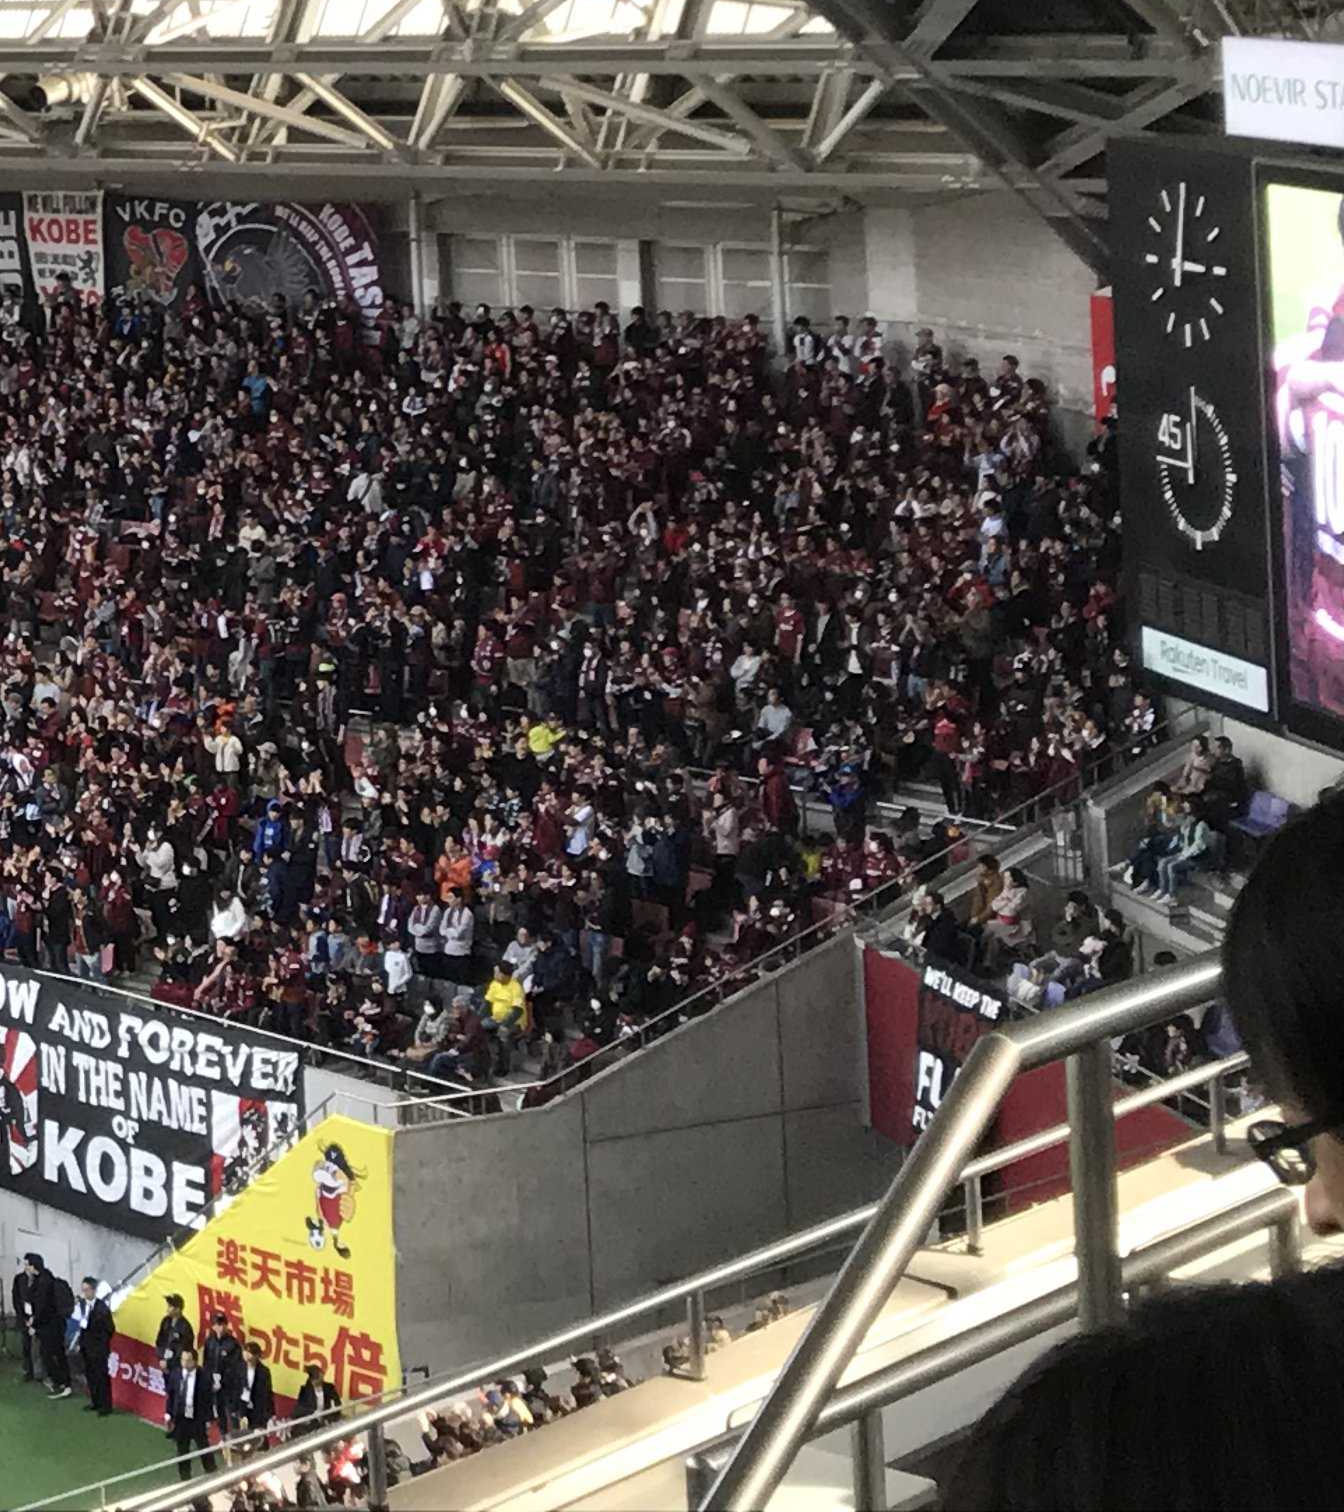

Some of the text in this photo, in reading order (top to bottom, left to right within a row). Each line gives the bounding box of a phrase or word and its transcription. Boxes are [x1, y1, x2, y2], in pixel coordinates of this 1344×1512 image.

[1231, 73, 1307, 107] NOEVIR
[28, 216, 98, 245] KOBE
[115, 200, 187, 229] VKFC
[1157, 412, 1182, 450] 45
[1160, 640, 1249, 691] Rakuten Travel
[48, 1002, 112, 1050] AND
[117, 1012, 299, 1096] FOREVER
[39, 1042, 208, 1136] IN THE NAME
[112, 1115, 140, 1146] OF
[43, 1119, 208, 1231] KOBE
[216, 1237, 356, 1320] 楽天市場
